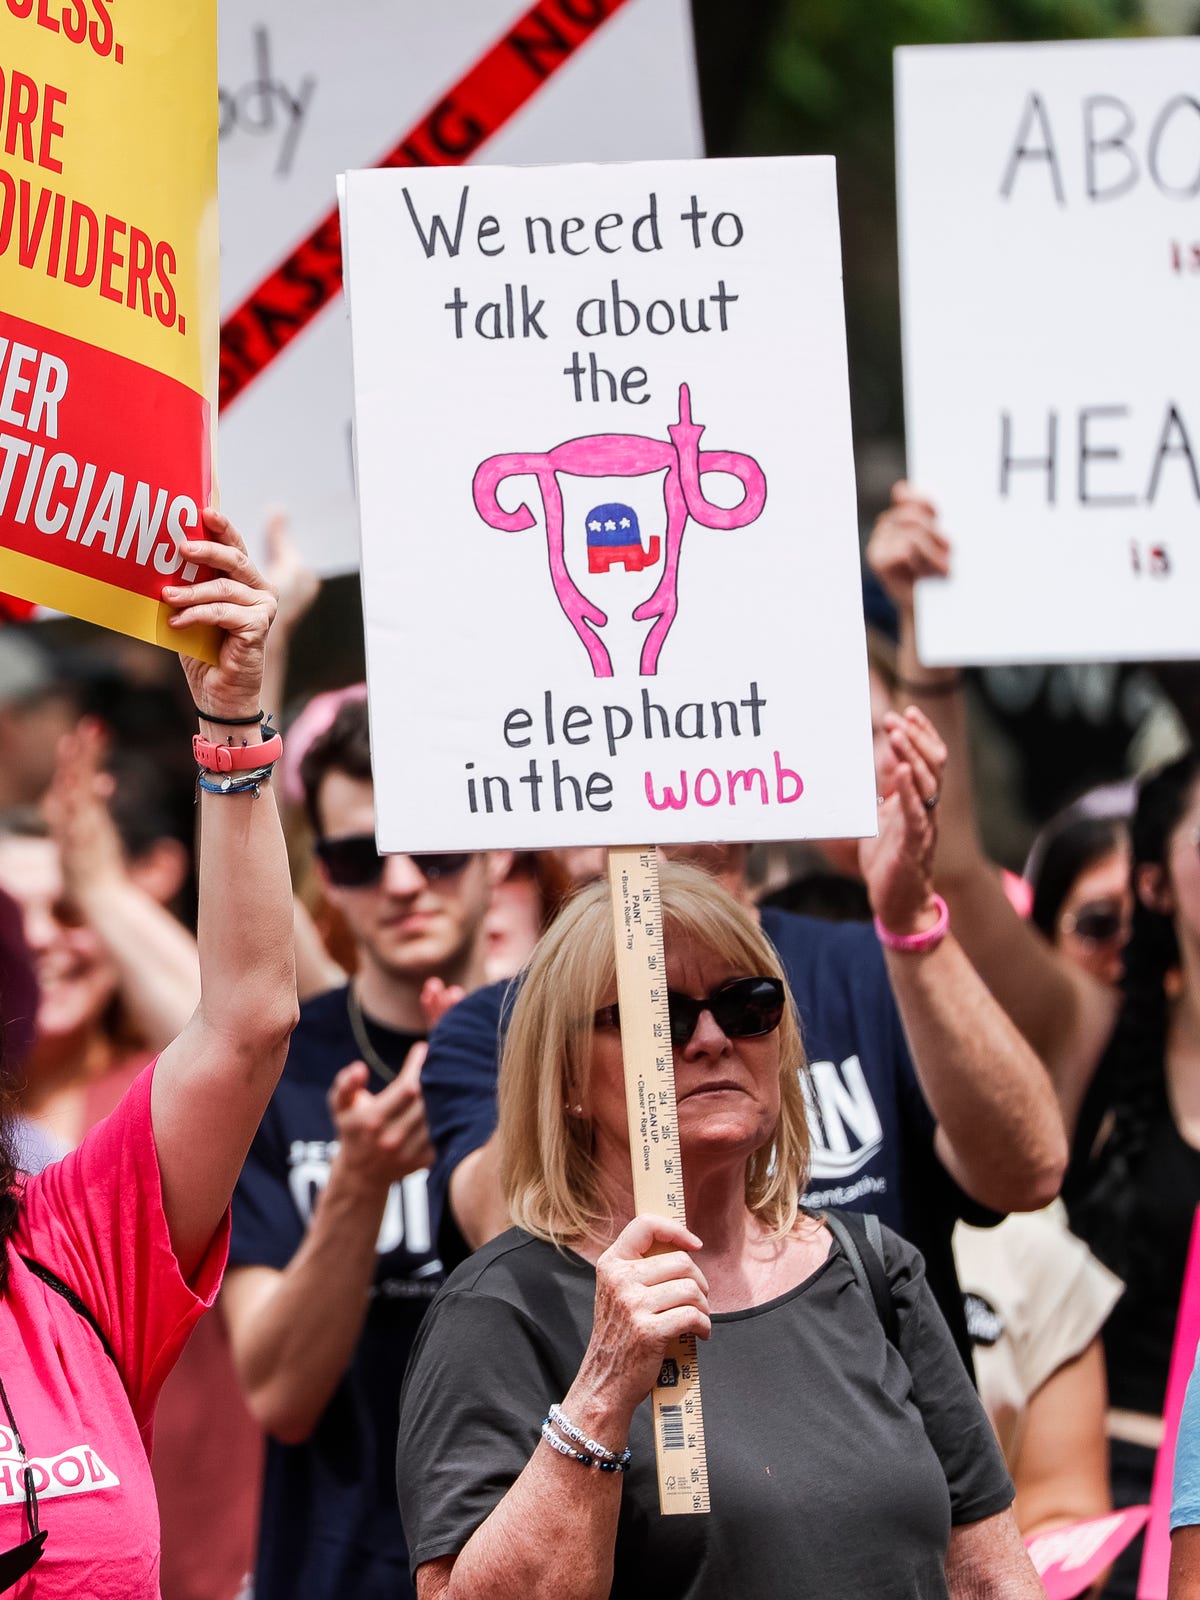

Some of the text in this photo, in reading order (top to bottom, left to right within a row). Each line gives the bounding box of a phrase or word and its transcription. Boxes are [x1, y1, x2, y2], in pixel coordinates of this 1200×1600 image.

[402, 186, 745, 258] We need to
[444, 279, 740, 340] talk about
[563, 352, 652, 405] the
[999, 398, 1200, 509] HEA
[503, 682, 767, 757] elephant
[644, 750, 805, 811] womb
[640, 854, 649, 868] 17
[642, 889, 652, 903] 18
[621, 875, 629, 899] Brush
[626, 934, 634, 951] Tray
[632, 895, 642, 925] PAINT
[645, 923, 655, 936] 19
[647, 956, 657, 970] 20
[650, 989, 660, 1003] 21
[653, 1023, 663, 1038] 22
[656, 1057, 666, 1072] 23
[638, 1080, 651, 1172] Cleaner Rags Gloves
[647, 1093, 660, 1144] CLEAN UP
[661, 1125, 671, 1140] 25
[664, 1159, 674, 1174] 26
[667, 1193, 677, 1208] 27
[681, 1364, 691, 1380] 32
[691, 1468, 700, 1483] 35
[693, 1495, 702, 1509] 36
